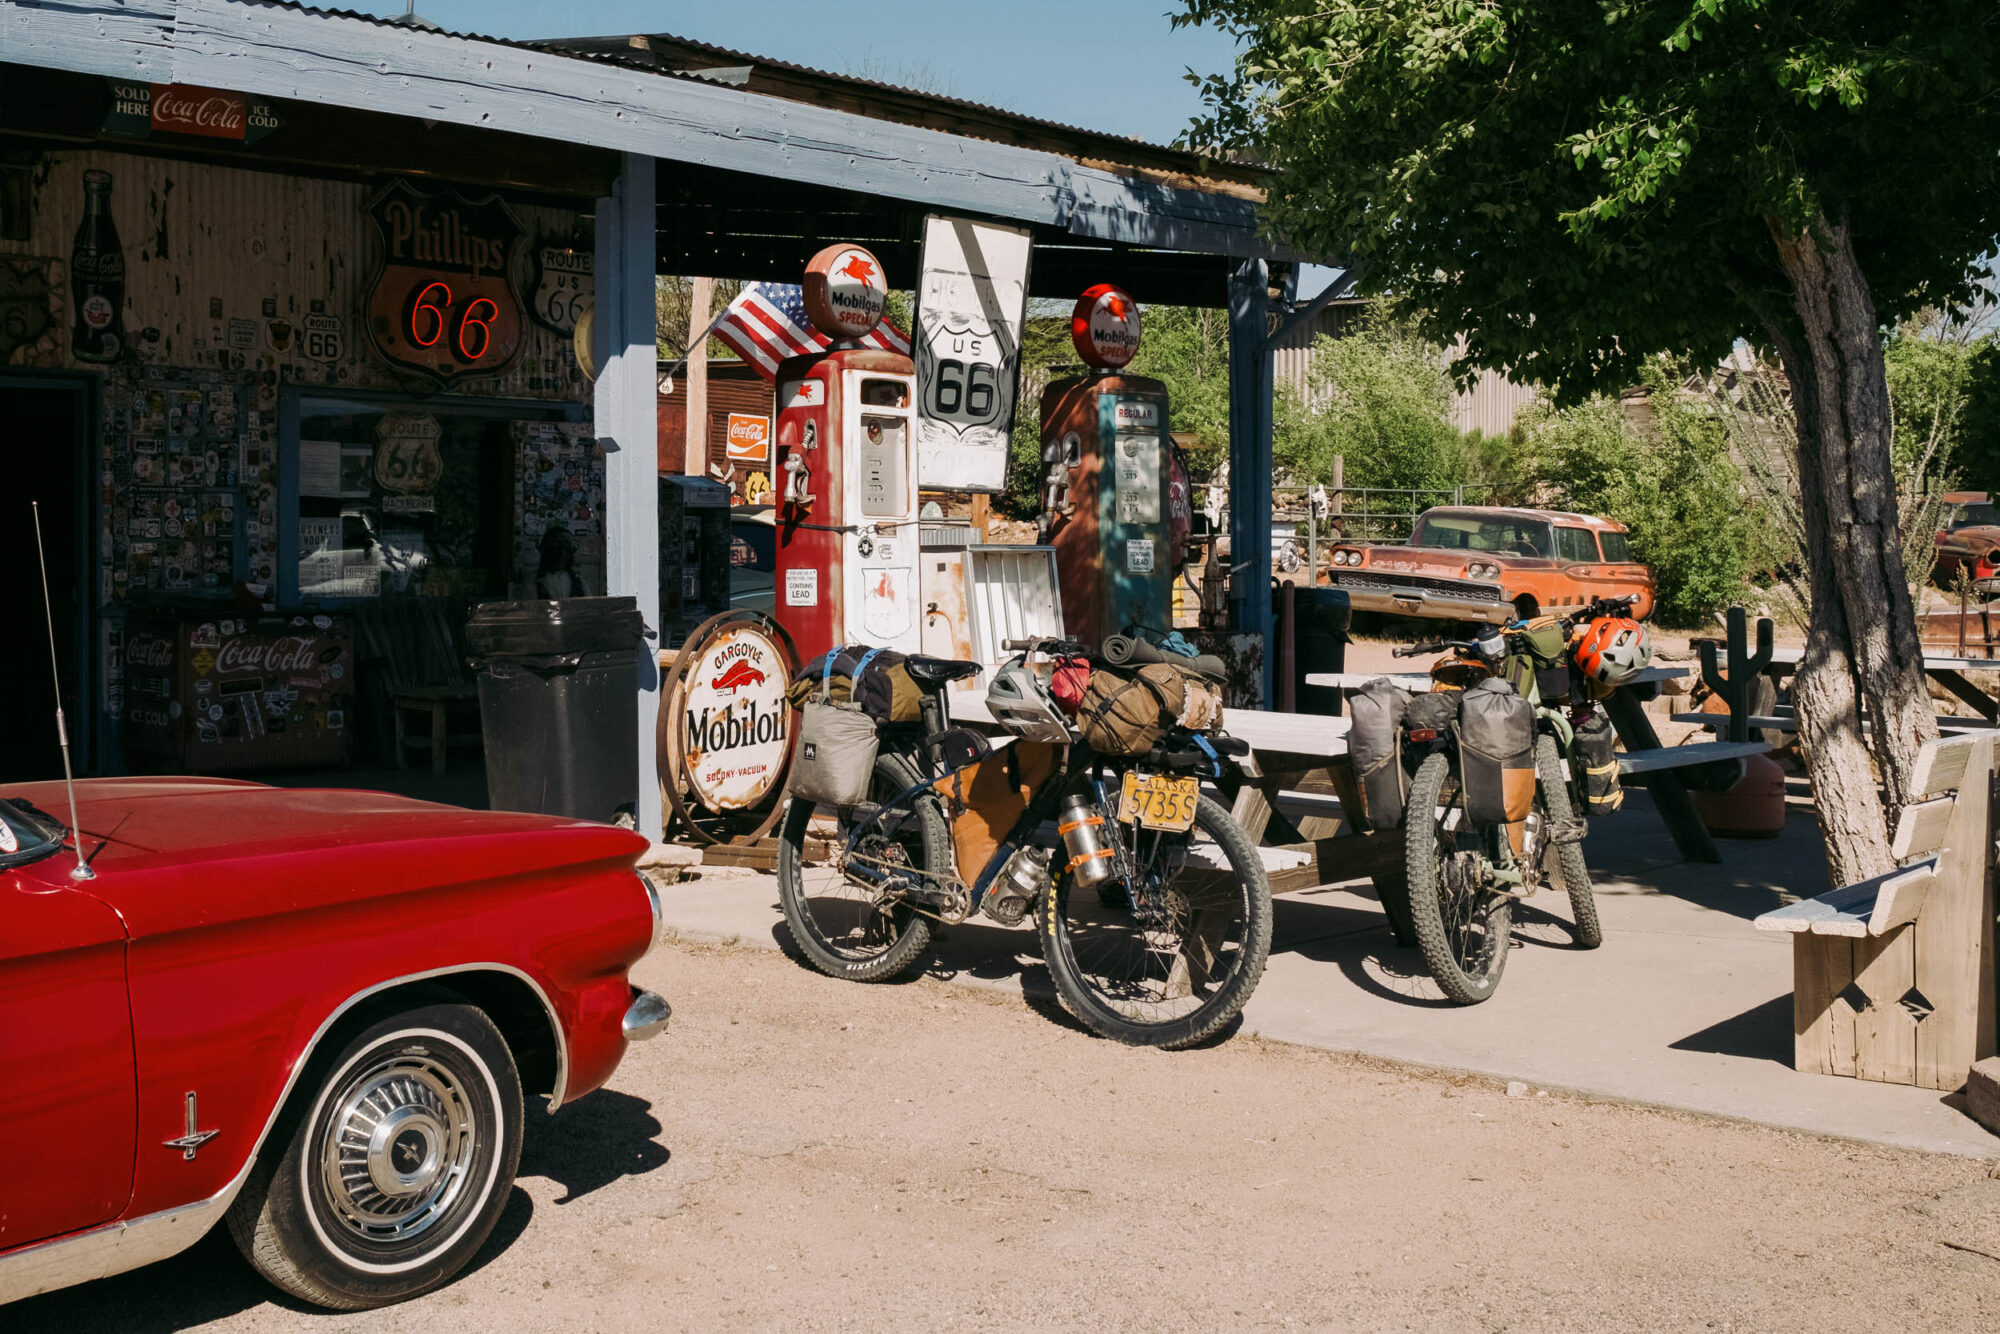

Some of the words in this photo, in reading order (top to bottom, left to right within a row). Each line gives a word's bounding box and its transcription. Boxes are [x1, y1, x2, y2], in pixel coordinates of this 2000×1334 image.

[114, 86, 150, 101] SOLD
[116, 101, 149, 117] HERE
[152, 91, 242, 129] Coca-Cola
[253, 104, 270, 117] ICE
[247, 115, 279, 128] COLD
[384, 200, 505, 282] Phillips
[547, 253, 591, 270] ROUTE
[832, 291, 880, 315] Mobilgas
[310, 319, 337, 329] ROUTE
[403, 279, 499, 364] 66
[839, 311, 873, 327] SPECIAL
[310, 333, 337, 357] 66
[1094, 328, 1138, 346] Mobilgas
[1101, 346, 1131, 359] SPECIAL
[935, 358, 995, 417] 66
[1118, 408, 1153, 420] REGULAR
[389, 423, 430, 434] ROUTE
[731, 422, 764, 440] Coca-Cola
[387, 444, 436, 480] 66
[1132, 557, 1149, 566] LEAD
[792, 590, 811, 599] LEAD
[127, 636, 173, 666] Coca-Cola
[215, 636, 317, 674] Coca-Cola
[714, 642, 764, 670] GARGOYLE
[145, 711, 169, 727] COLD
[687, 696, 787, 754] Mobiloil
[1145, 778, 1197, 794] ALASKA
[846, 953, 888, 971] MAXXIS
